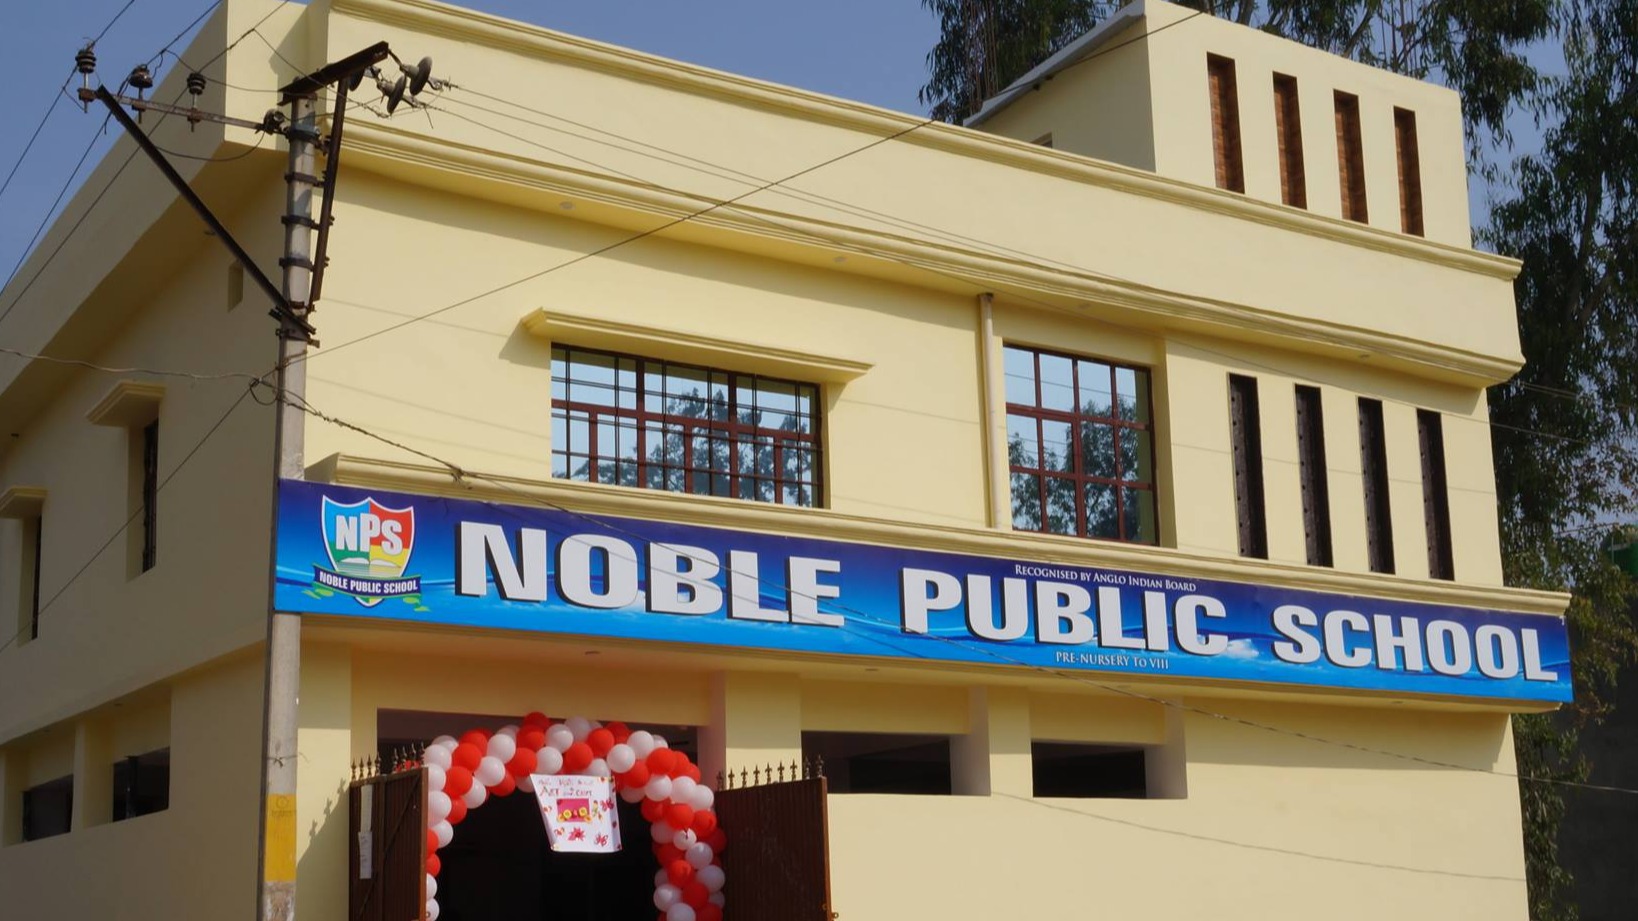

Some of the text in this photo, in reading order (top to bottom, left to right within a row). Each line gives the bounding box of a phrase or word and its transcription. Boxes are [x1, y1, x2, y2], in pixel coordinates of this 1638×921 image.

[335, 513, 403, 555] NPS
[319, 571, 418, 594] NOBLE PUBLIC SCHOOL
[460, 521, 1558, 681] NOBLE PUBLIC SCHOOL
[1055, 651, 1129, 666] PRE-NURSERY
[1150, 658, 1169, 669] VIII
